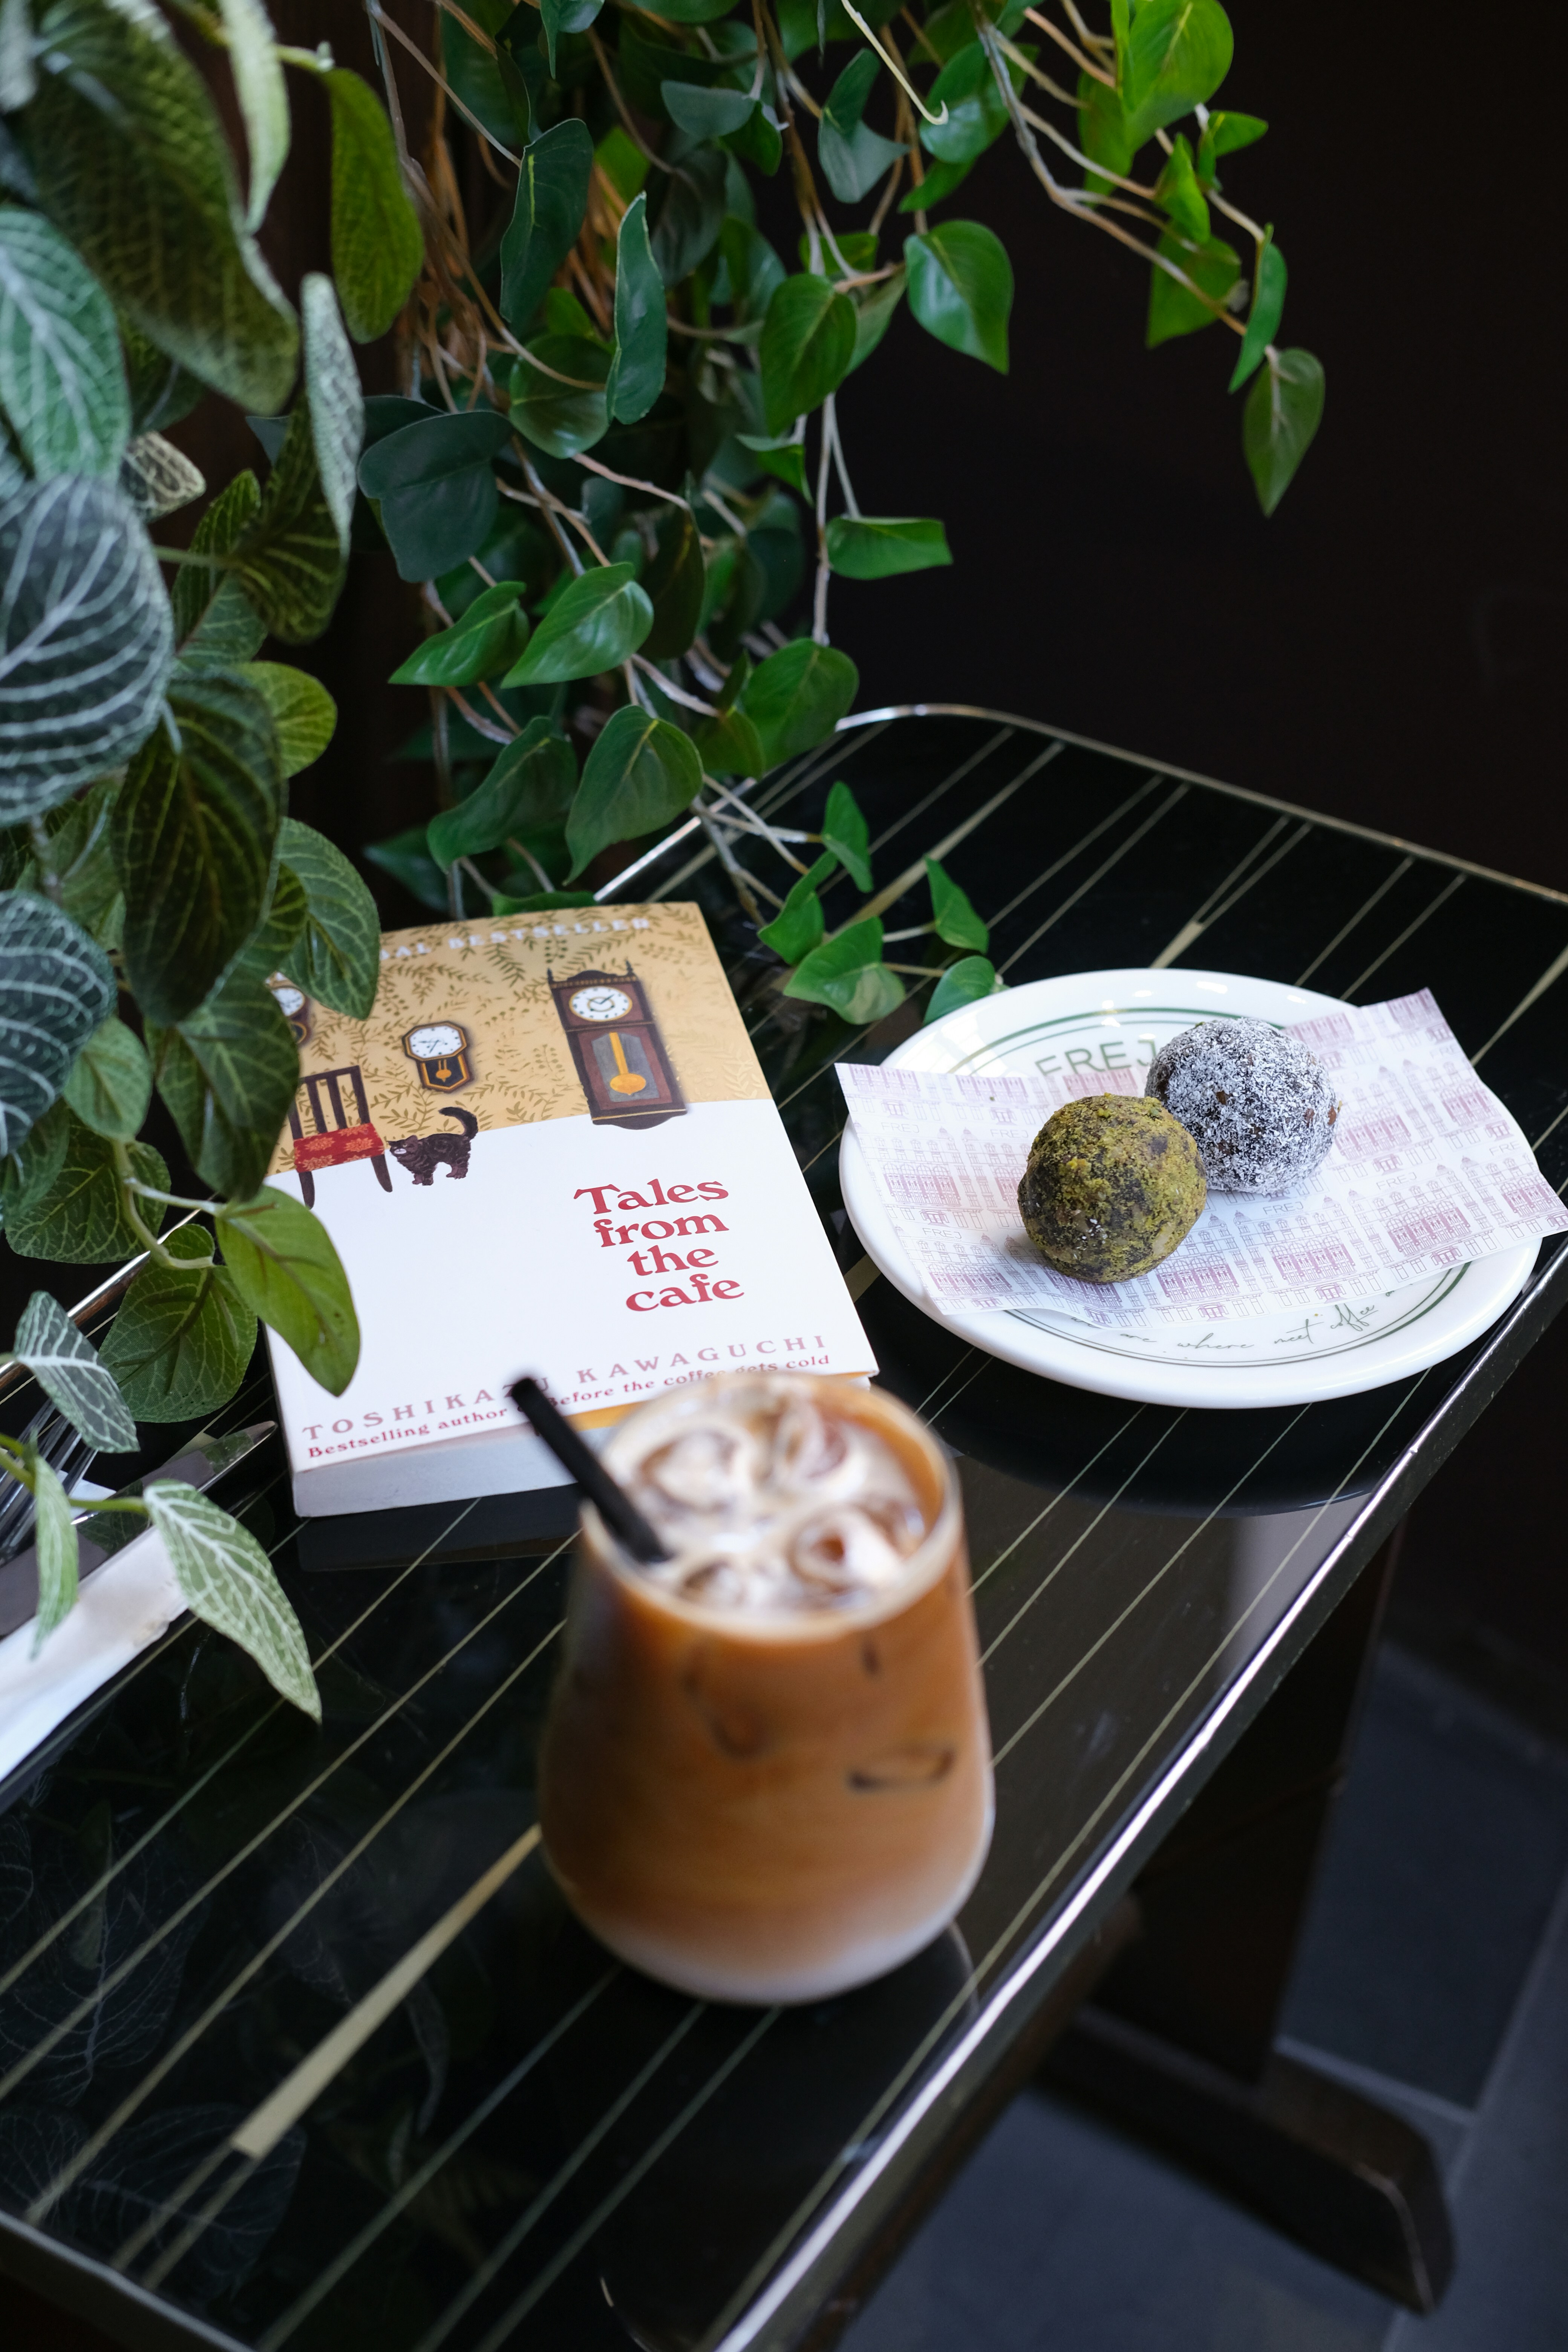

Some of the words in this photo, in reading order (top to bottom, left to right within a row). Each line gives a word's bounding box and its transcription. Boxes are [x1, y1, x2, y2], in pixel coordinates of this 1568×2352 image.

[449, 918, 649, 949] BESTSELLER
[574, 1179, 729, 1214] Tales
[1376, 1172, 1417, 1190] FREJ
[1262, 1201, 1304, 1215] FREJ
[593, 1214, 729, 1247] from
[922, 1227, 962, 1239] FREJ
[627, 1245, 718, 1276] the
[626, 1274, 744, 1311] cafe
[577, 1335, 826, 1384] KAWAGUCHI
[308, 1423, 430, 1458] Bestselling
[438, 1408, 508, 1429] author
[623, 1380, 654, 1393] the
[786, 1354, 829, 1369] cold
